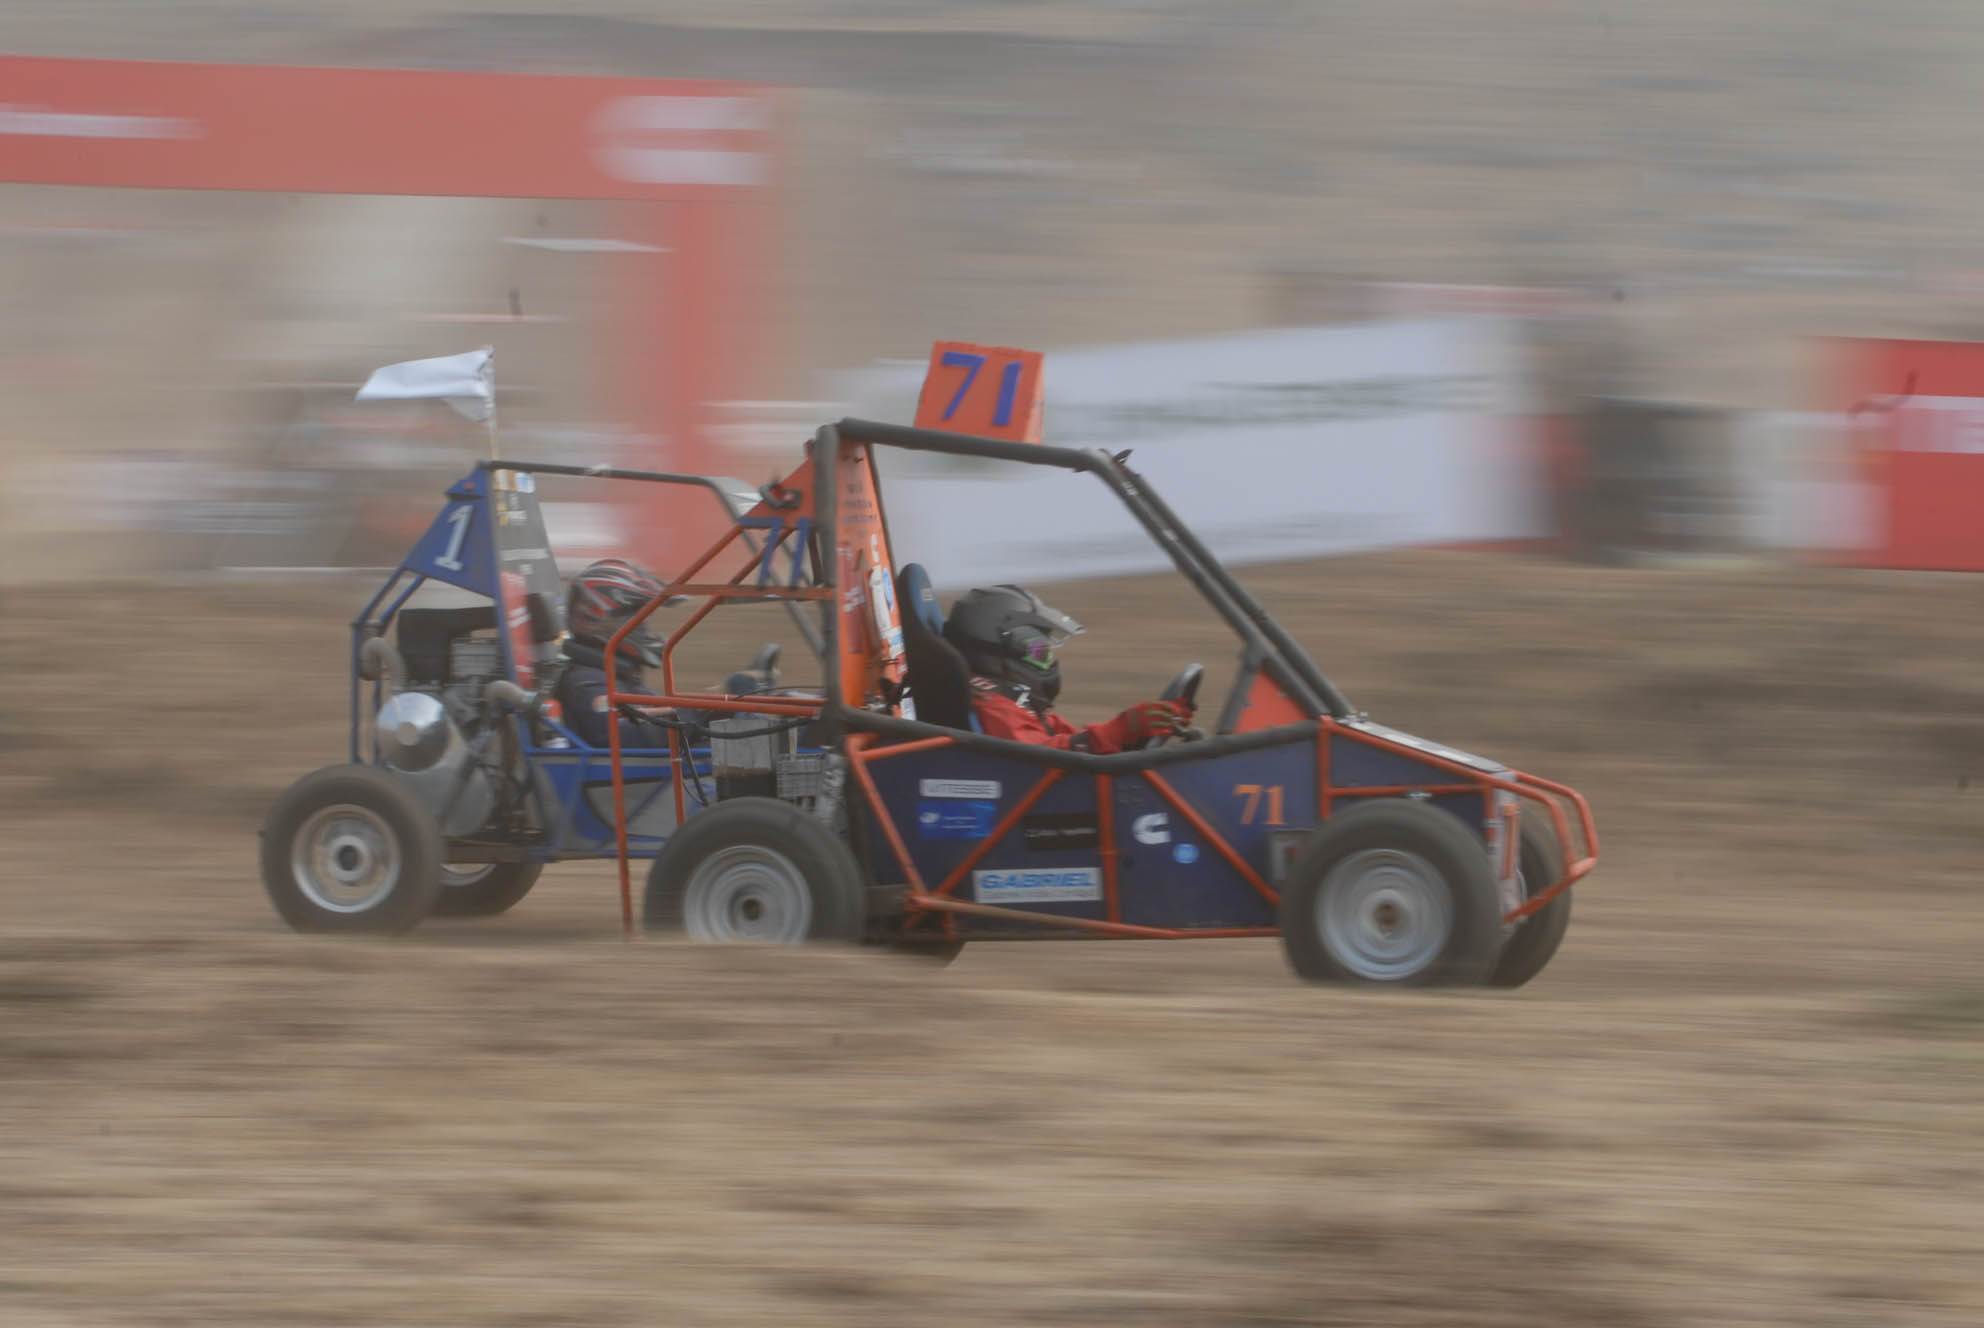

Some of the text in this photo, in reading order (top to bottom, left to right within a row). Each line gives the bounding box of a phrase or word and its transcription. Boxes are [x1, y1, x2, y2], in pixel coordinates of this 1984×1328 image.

[940, 351, 1023, 427] 71
[434, 505, 473, 571] 1
[1233, 784, 1288, 826] 71
